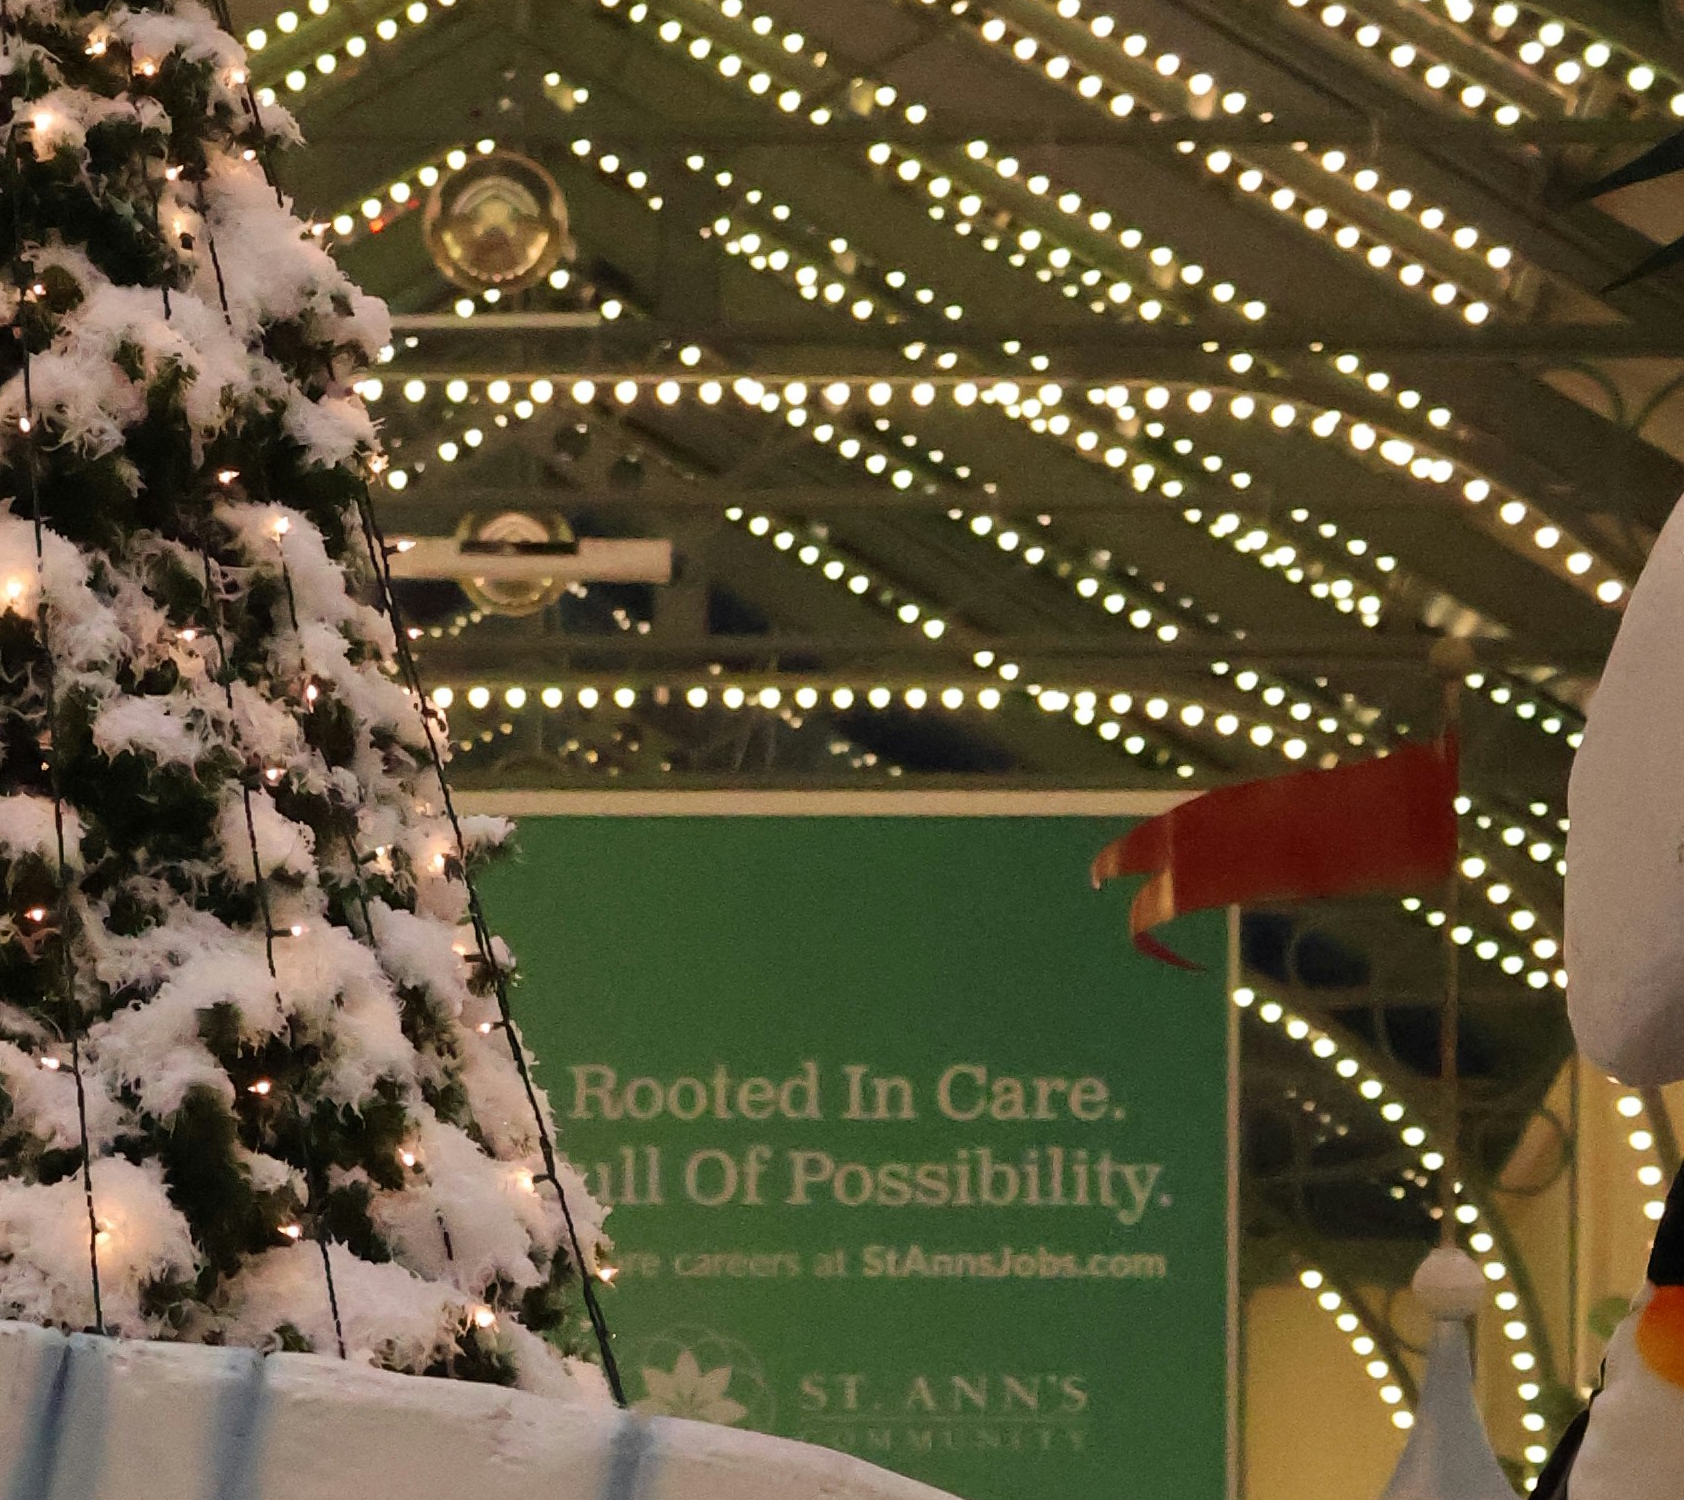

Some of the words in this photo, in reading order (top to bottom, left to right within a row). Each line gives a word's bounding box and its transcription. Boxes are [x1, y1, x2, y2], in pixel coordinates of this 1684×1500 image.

[568, 1060, 823, 1121] Rooted
[842, 1064, 918, 1121] In
[936, 1063, 1127, 1122] Care.
[684, 1145, 772, 1207] Of
[785, 1146, 1172, 1226] Possibility.
[673, 1251, 801, 1279] careers
[814, 1248, 847, 1278] at
[862, 1244, 1167, 1279] StAnnsJobs.com
[800, 1373, 882, 1411] ST.
[905, 1375, 1089, 1412] ANN'S
